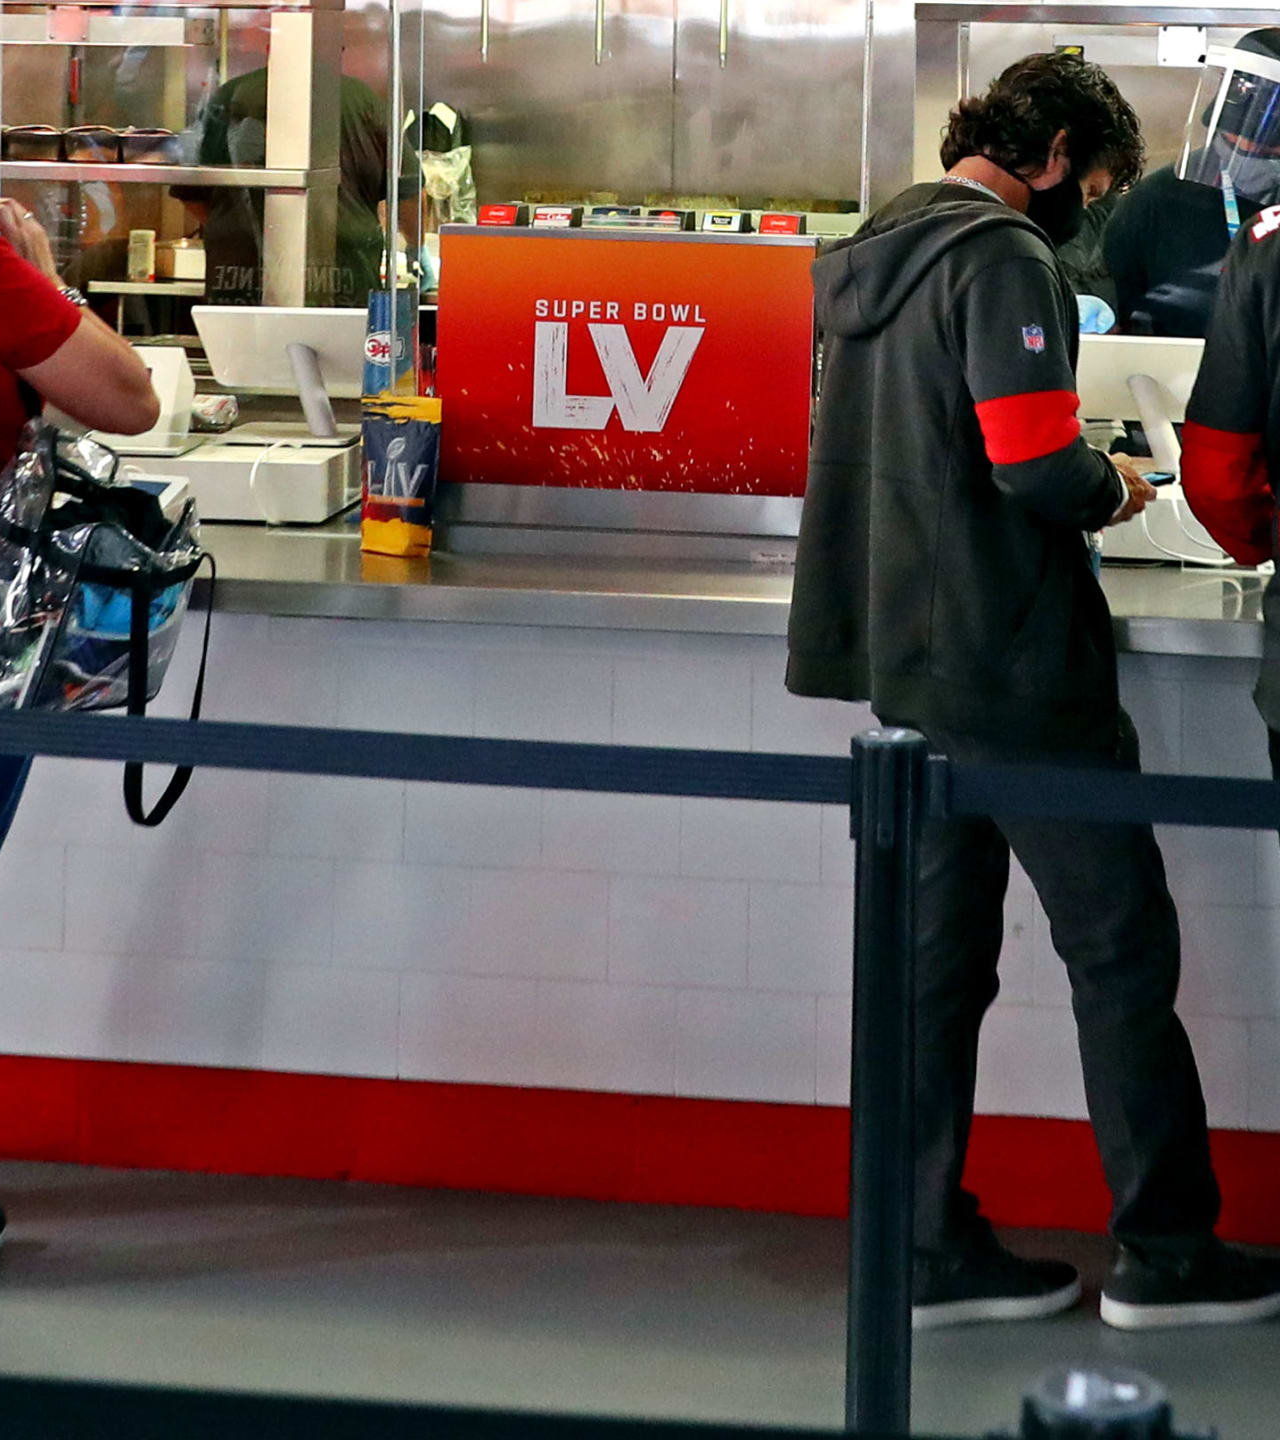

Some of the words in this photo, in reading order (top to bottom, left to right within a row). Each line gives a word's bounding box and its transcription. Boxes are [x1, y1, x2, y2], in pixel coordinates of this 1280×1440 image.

[534, 299, 621, 320] SUPER
[633, 302, 708, 323] BOWL
[532, 320, 707, 433] LV
